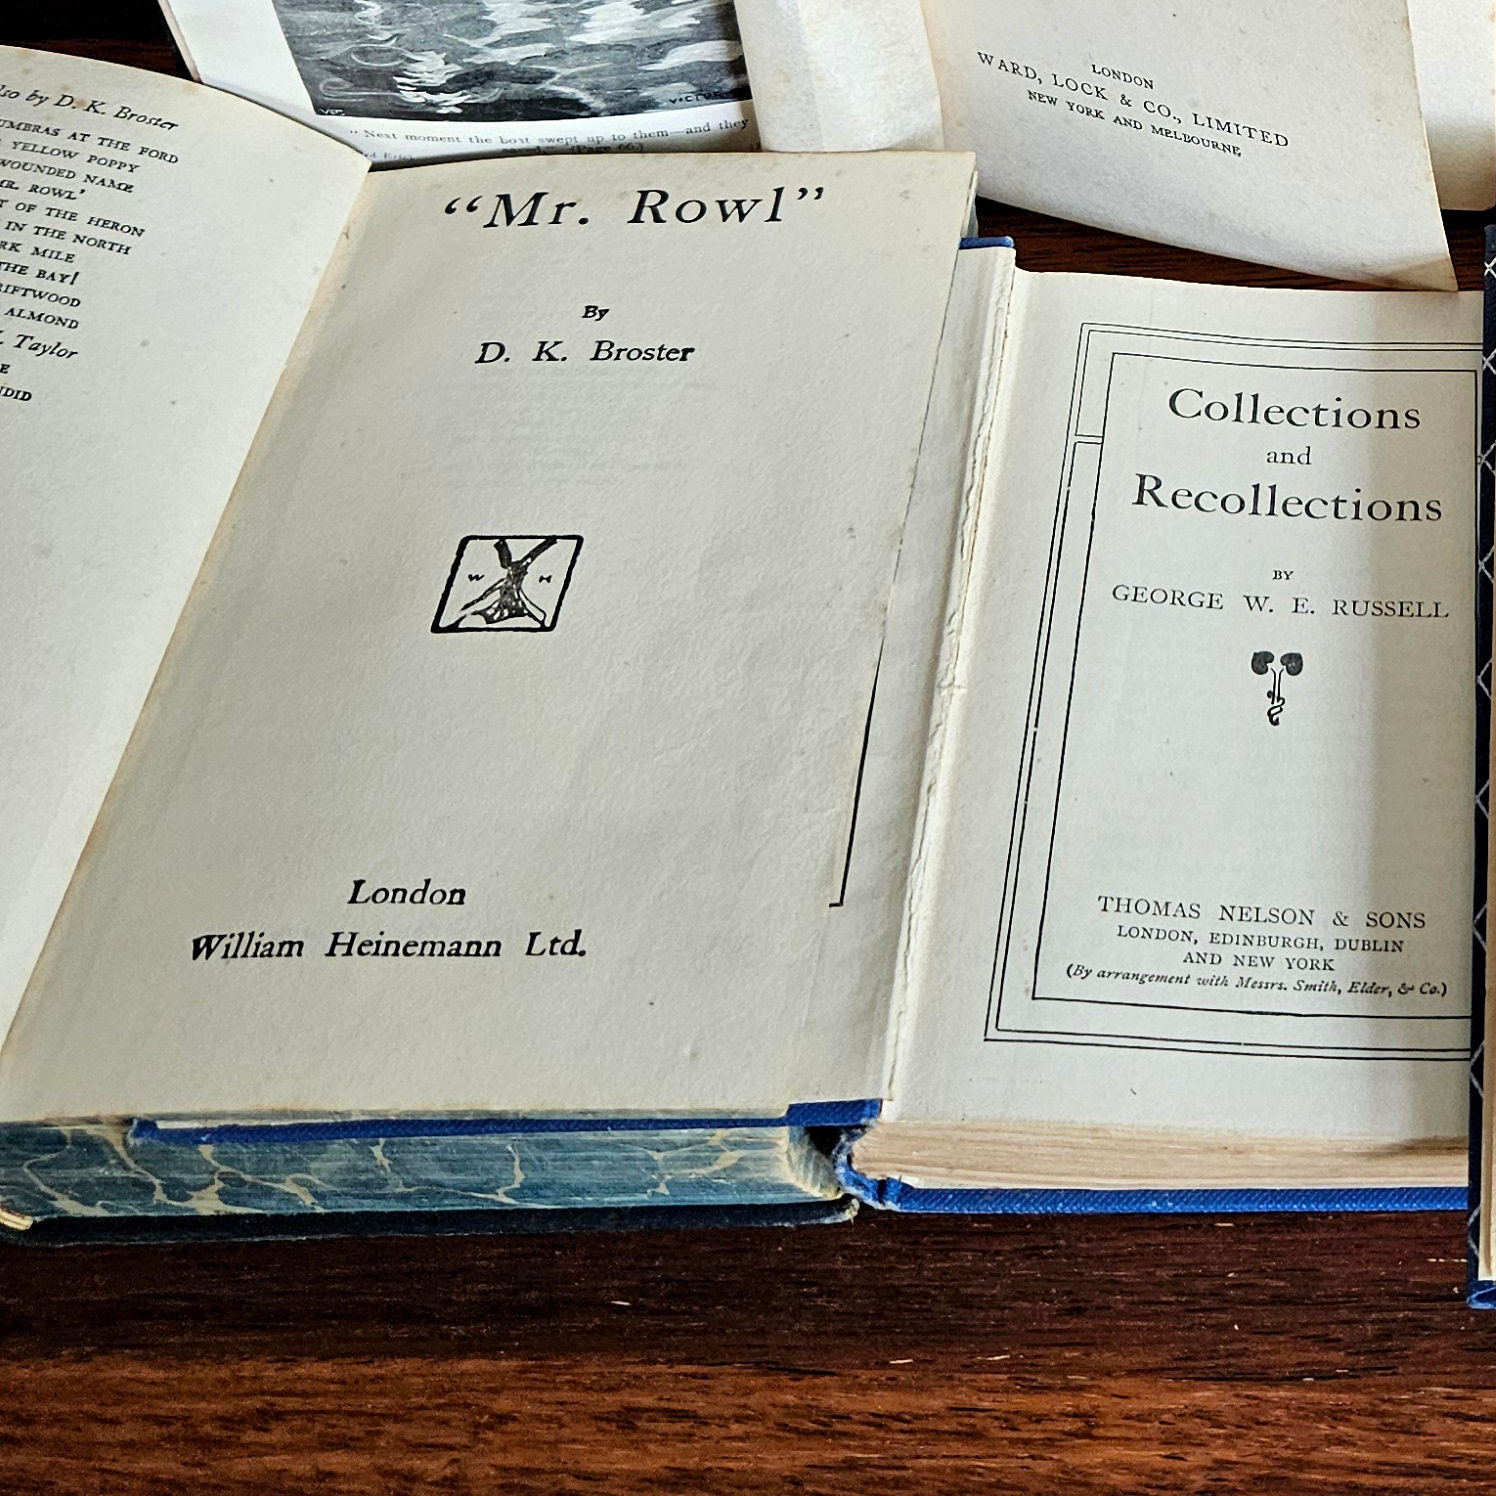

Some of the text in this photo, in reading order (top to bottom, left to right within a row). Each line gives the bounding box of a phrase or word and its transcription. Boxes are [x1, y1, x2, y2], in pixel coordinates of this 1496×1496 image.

[1092, 64, 1154, 90] LONDON
[26, 90, 178, 130] by D. K. Broster
[978, 52, 1288, 150] WARD, LOCK & CO., LIMITED
[1027, 90, 1241, 157] NEW YORK AND MELBOURNE
[12, 141, 140, 173] YELLOW POPPY
[98, 137, 178, 163] THE FORD
[83, 174, 134, 193] NAME
[45, 207, 145, 237] THE HERON
[31, 247, 75, 263] MILE
[72, 234, 131, 255] NORTH
[4, 308, 79, 329] ALMOND
[582, 305, 609, 321] By
[13, 334, 78, 358] Taylor
[475, 340, 695, 364] D. K. Broster
[1169, 389, 1420, 429] Collections
[1267, 446, 1311, 465] and
[1132, 473, 1441, 522] Recollections
[1273, 570, 1293, 580] BY
[1113, 585, 1449, 617] GEORGE W. E. RUSSELL
[347, 878, 465, 905] London
[1098, 896, 1425, 928] THOMAS NELSON & SONS
[193, 929, 586, 960] William Heinemann Ltd.
[1117, 925, 1404, 952] LONDON, EDINBURGH, DUBLIN
[1183, 952, 1335, 971] AND NEW YORK
[1097, 970, 1414, 998] arrangement with Messrs. Smith, Elder, &
